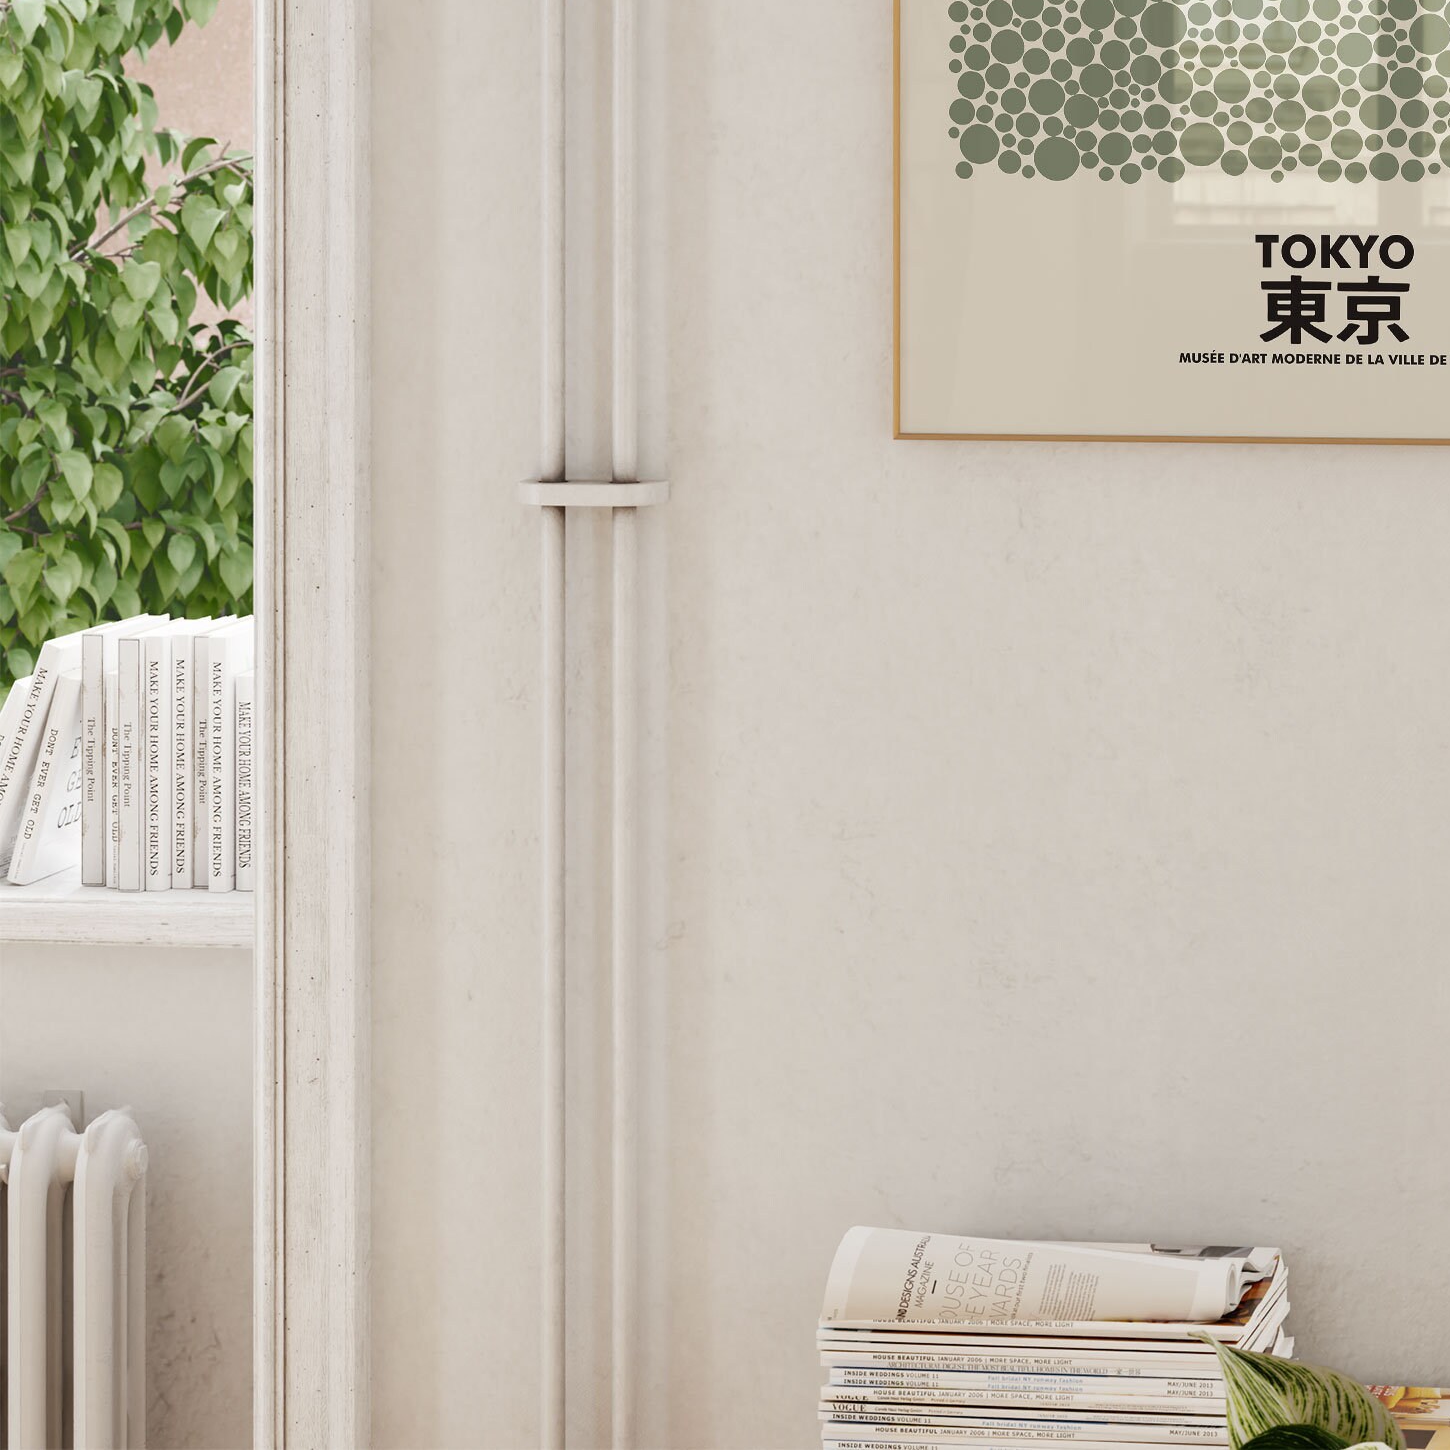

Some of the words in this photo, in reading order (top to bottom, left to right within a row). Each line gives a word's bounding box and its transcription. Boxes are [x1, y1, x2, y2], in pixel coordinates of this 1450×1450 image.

[1255, 233, 1415, 270] TOKYO
[1259, 274, 1411, 345] 東京
[1179, 350, 1225, 364] MUSÉE
[1229, 353, 1267, 364] D'ART
[1271, 353, 1341, 365] MODERNE
[1345, 354, 1363, 365] DE
[1367, 354, 1385, 365] LA
[1388, 354, 1425, 366] VILLE
[1429, 354, 1447, 366] DE
[30, 667, 48, 701] MAKE
[149, 661, 159, 695] MAKE
[176, 659, 185, 693] MAKE
[213, 662, 222, 696] MAKE
[17, 703, 36, 735] YOUR
[87, 717, 96, 736] The
[149, 698, 159, 732] YOUR
[176, 696, 185, 729] YOUR
[199, 718, 207, 738] The
[213, 699, 222, 732] YOUR
[238, 701, 251, 728] MAKE
[123, 721, 132, 741] The
[238, 730, 251, 757] YOUR
[4, 736, 25, 773] HOME
[86, 737, 96, 775] Tipping
[149, 735, 159, 772] HOME
[176, 733, 185, 770] HOME
[213, 736, 222, 773] HOME
[87, 778, 95, 802] Point
[238, 759, 251, 788] HOME
[30, 793, 42, 814] GET
[123, 783, 131, 807] Point
[149, 775, 159, 822] AMONG
[176, 773, 185, 819] AMONG
[199, 780, 207, 804] Point
[213, 776, 222, 823] AMONG
[238, 790, 251, 827] AMONG
[23, 819, 35, 840] OLD
[149, 825, 159, 876] FRIENDS
[176, 822, 185, 874] FRIENDS
[213, 826, 222, 877] FRIENDS
[238, 828, 251, 869] FRIENDS
[899, 1269, 918, 1313] DESIGNS
[914, 1260, 935, 1309] MAGAZINE
[969, 1249, 1001, 1300] YEAR
[832, 1403, 867, 1412] VOGUE
[832, 1413, 857, 1421] INSIDE
[857, 1414, 895, 1422] WEDDINGS
